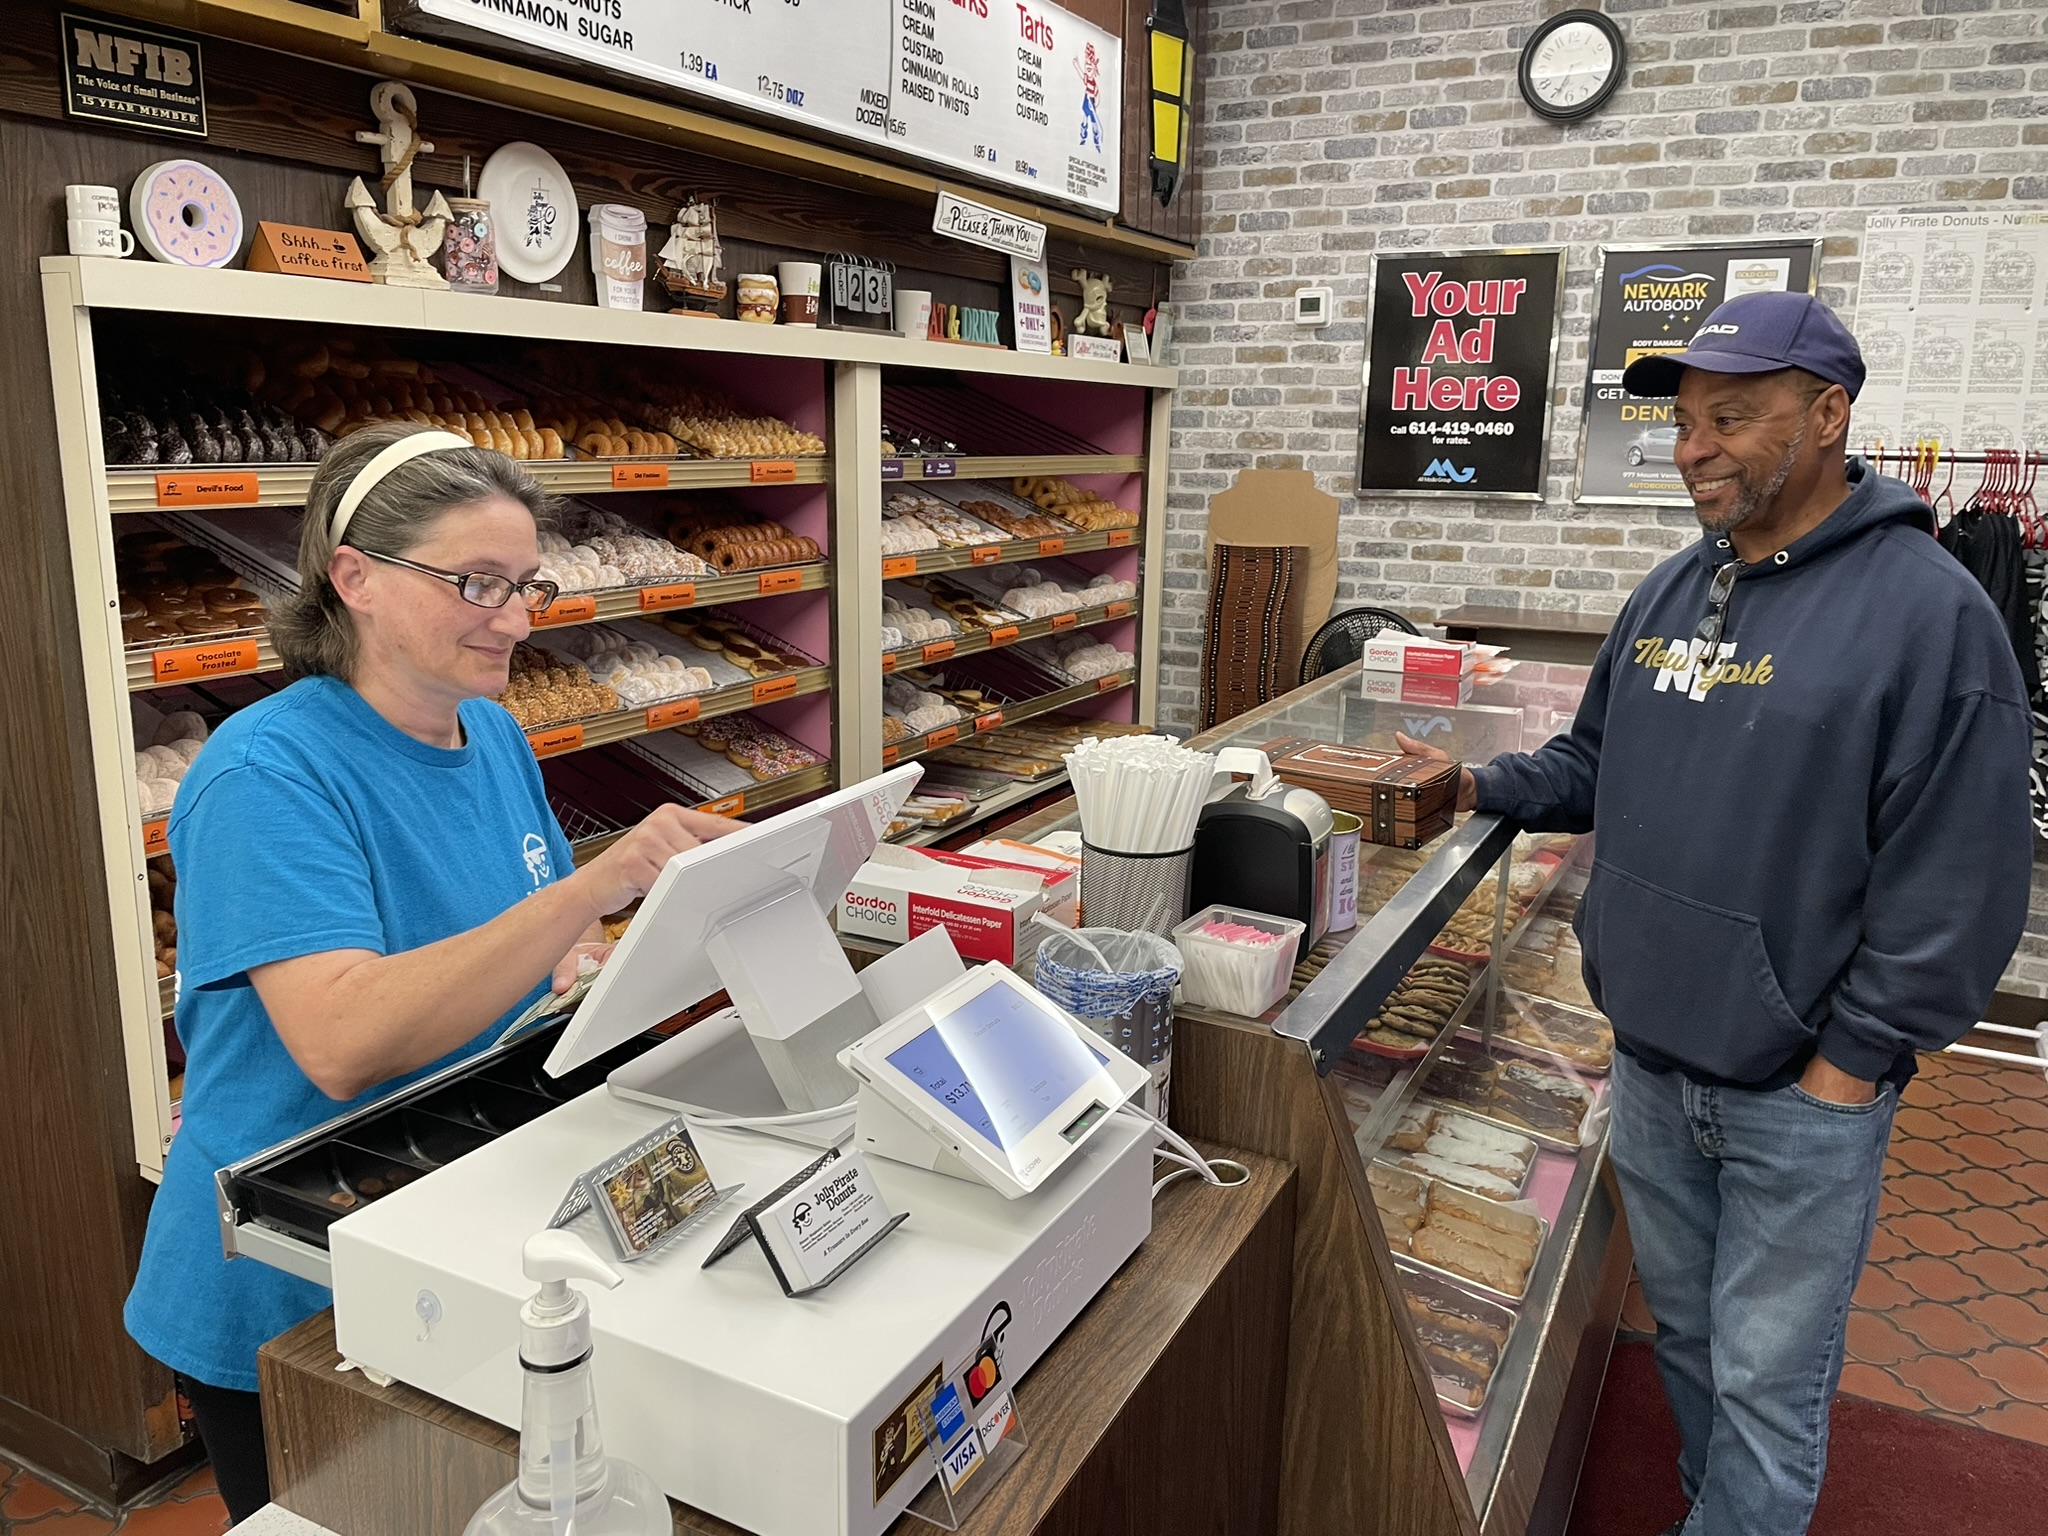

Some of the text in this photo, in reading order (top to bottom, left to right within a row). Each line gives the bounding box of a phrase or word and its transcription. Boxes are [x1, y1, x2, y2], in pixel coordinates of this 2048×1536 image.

[903, 0, 936, 21] LEMON
[578, 17, 633, 51] SUGAR
[902, 14, 935, 41] CREAM
[1016, 2, 1054, 51] Tarts
[74, 28, 193, 86] NFIB
[902, 36, 944, 65] CUSTARD
[1017, 47, 1042, 70] CREAM
[680, 51, 718, 80] 1.39 EA
[1017, 65, 1042, 88] LEMON
[76, 74, 95, 86] The
[96, 78, 120, 91] Voice
[121, 84, 132, 93] of
[133, 85, 158, 98] Small
[901, 57, 979, 100] CINNAMON ROLLS
[757, 74, 805, 107] 12.75 DOZ
[860, 88, 889, 110] MIXED
[901, 78, 970, 116] RAISED TWISTS
[1016, 84, 1045, 106] CHERRY
[82, 96, 197, 123] 15 YEAR MEMBER
[856, 107, 887, 128] DOZEN
[1016, 103, 1049, 126] CUSTARD
[988, 148, 997, 162] EA
[981, 221, 988, 236] &
[1867, 216, 1897, 229] Jolly
[1900, 215, 1938, 228] Pirate
[1942, 214, 1989, 227] Donuts
[281, 252, 363, 273] coffee first
[604, 250, 644, 276] coffee
[610, 295, 640, 304] PROTECTION
[624, 287, 637, 295] YOUR
[1401, 271, 1527, 318] Your
[1623, 282, 1709, 300] NEWARK
[1018, 302, 1045, 317] PARKING
[1623, 298, 1705, 312] AUTOBODY
[948, 304, 960, 340] &
[961, 306, 1000, 345] DRINK
[1025, 317, 1040, 332] ONLY
[1420, 318, 1496, 364] Ad
[1391, 366, 1521, 412] Here
[1597, 388, 1625, 400] GET
[1390, 421, 1515, 436] Call 614-419-0460
[1432, 435, 1471, 445] for rates.
[196, 484, 244, 493] Devil's Food
[559, 607, 587, 615] Strawberry
[196, 650, 242, 662] Chocolate
[1369, 648, 1398, 656] Gordon
[1634, 636, 1690, 672] New
[202, 659, 237, 670] Frosted
[543, 735, 577, 747] Peanut Donut
[845, 891, 898, 913] Gordon
[912, 903, 1002, 929] Interfold Delicatessen Paper
[929, 1076, 947, 1091] Total
[1024, 1156, 1042, 1174] clover
[814, 1184, 836, 1206] Jolly
[832, 1168, 859, 1191] Pirate
[826, 1183, 857, 1212] Donuts
[827, 1236, 846, 1253] Treasure
[936, 1396, 958, 1420] AMERICAN
[941, 1404, 962, 1428] EXPRESS
[948, 1441, 977, 1475] VISA
